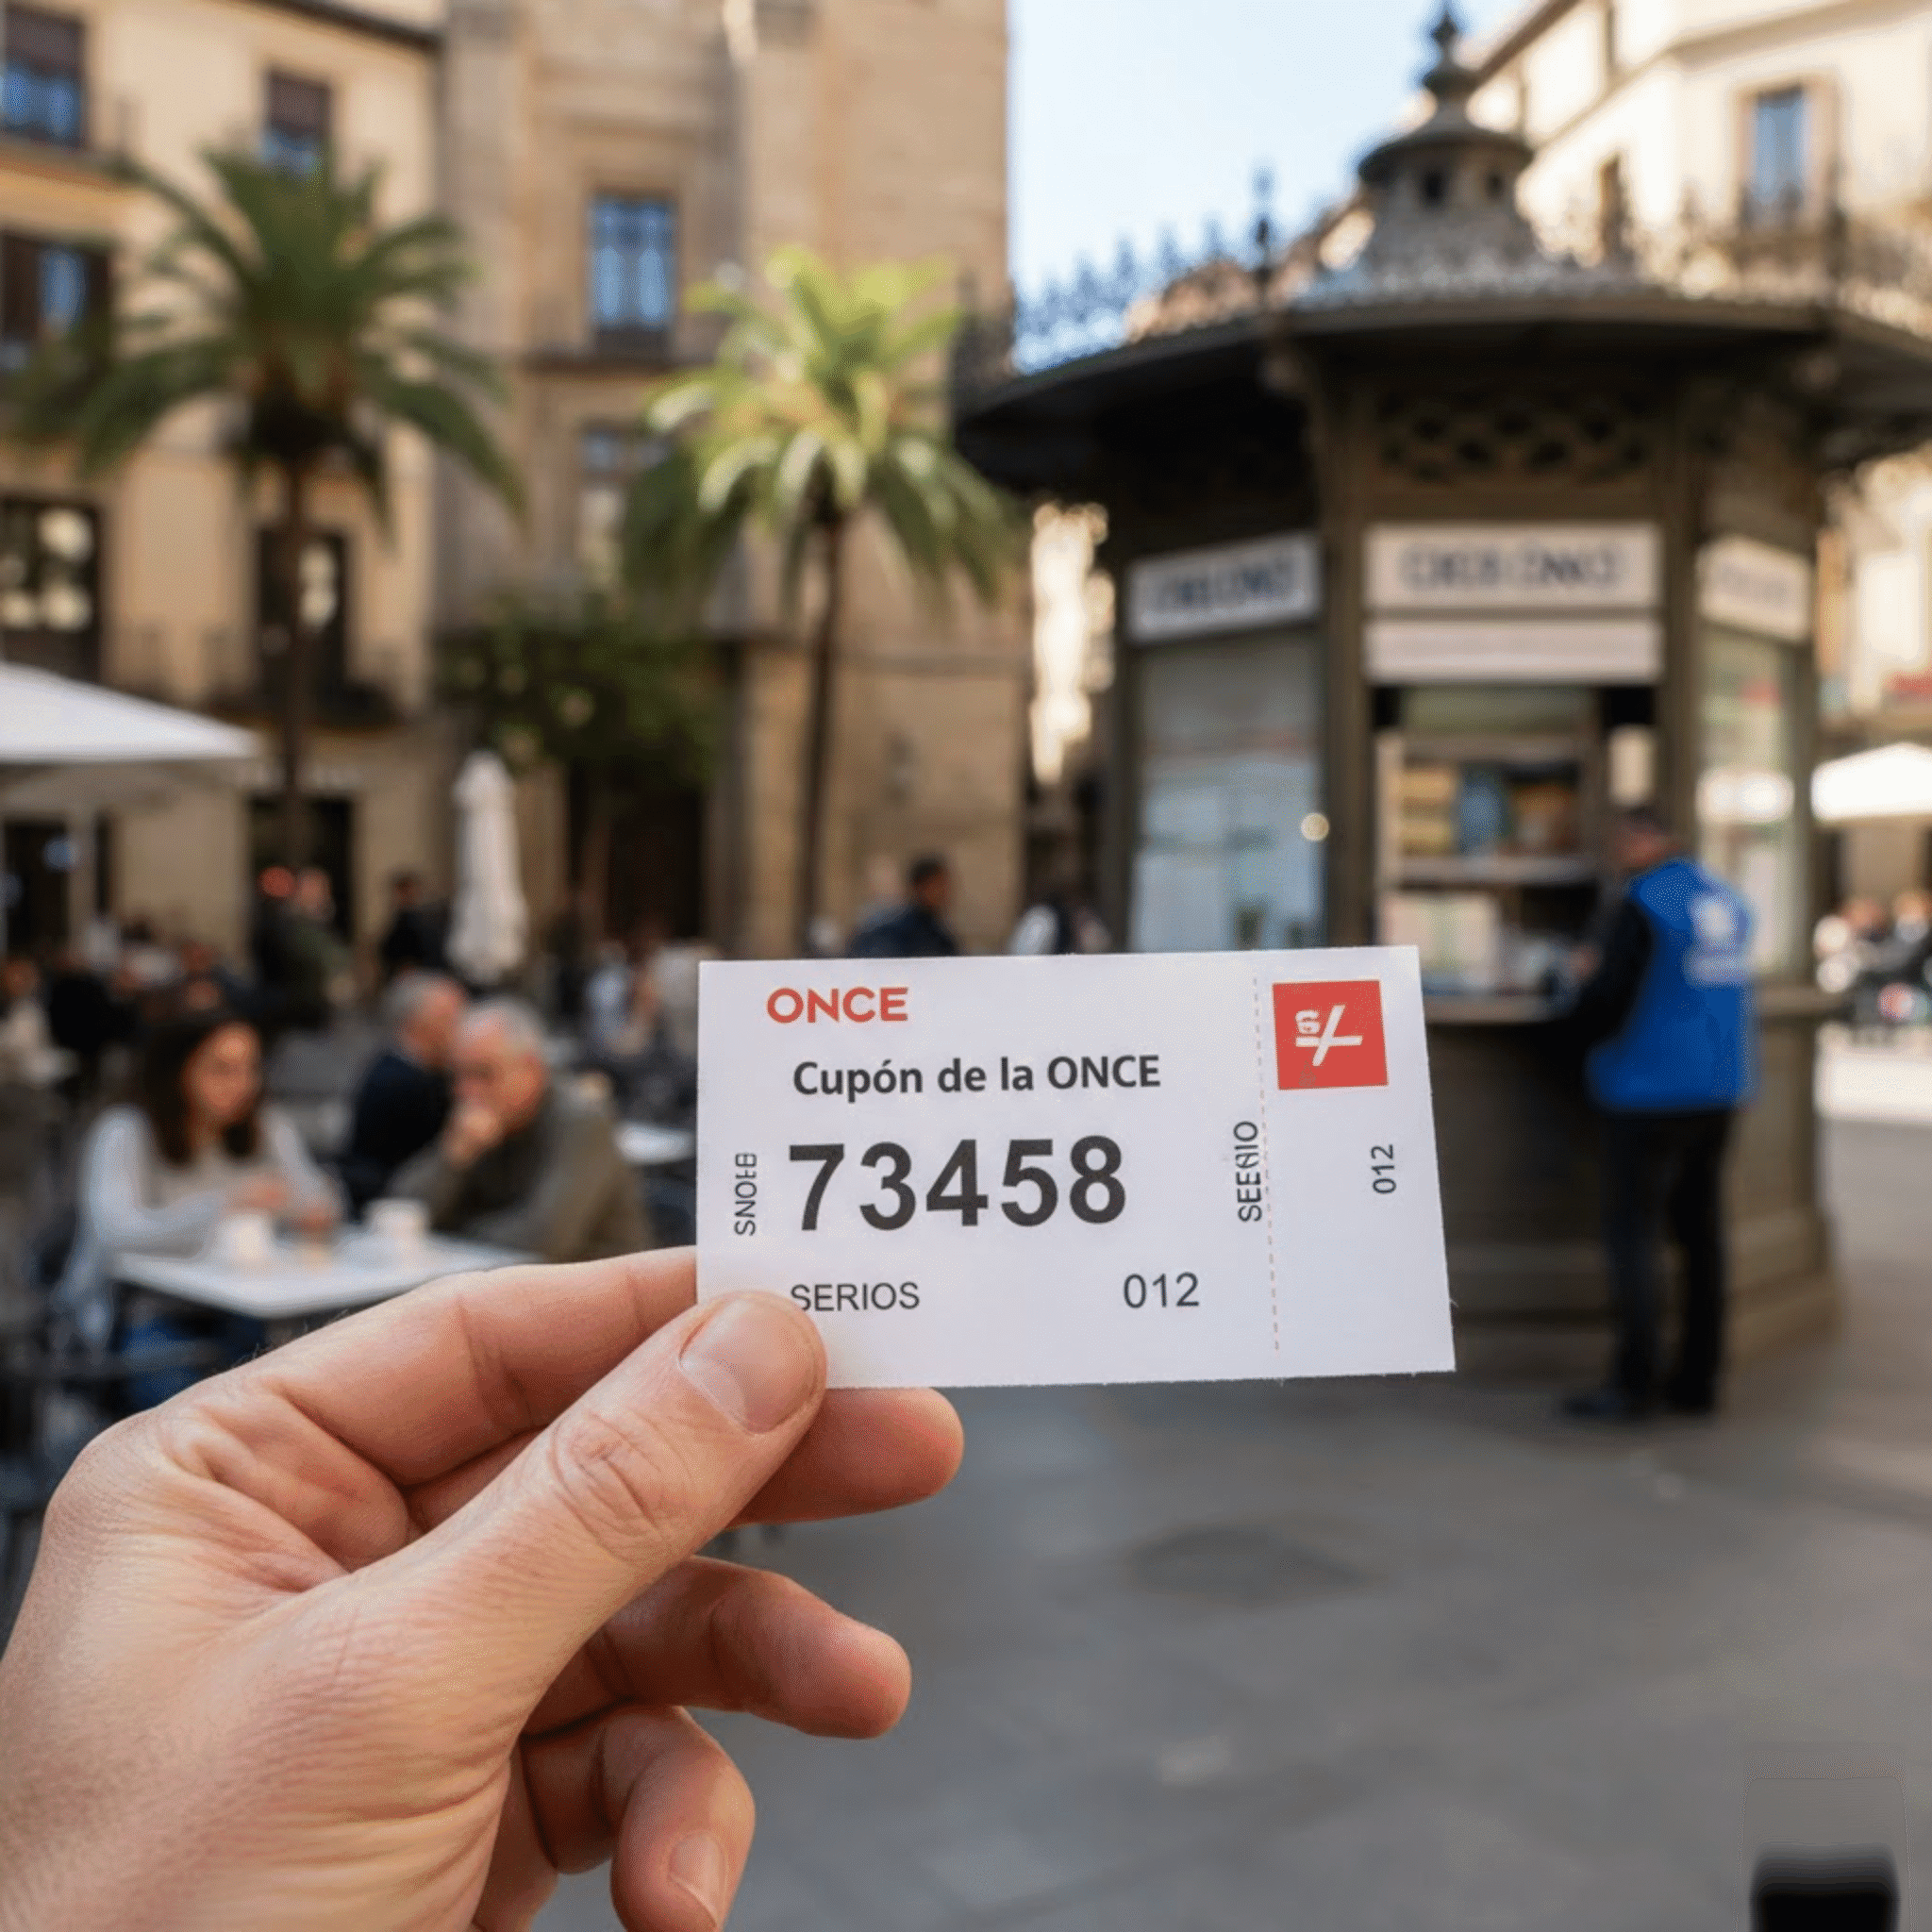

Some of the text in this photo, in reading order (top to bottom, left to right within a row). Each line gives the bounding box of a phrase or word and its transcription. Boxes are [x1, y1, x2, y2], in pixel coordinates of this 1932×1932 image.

[767, 987, 909, 1024] ONCE
[792, 1054, 1161, 1104] Cupón de la ONCE
[788, 1135, 1127, 1231] 73458
[1370, 1143, 1397, 1195] 012
[790, 1281, 921, 1312] SERIOS
[1123, 1271, 1200, 1309] 012
